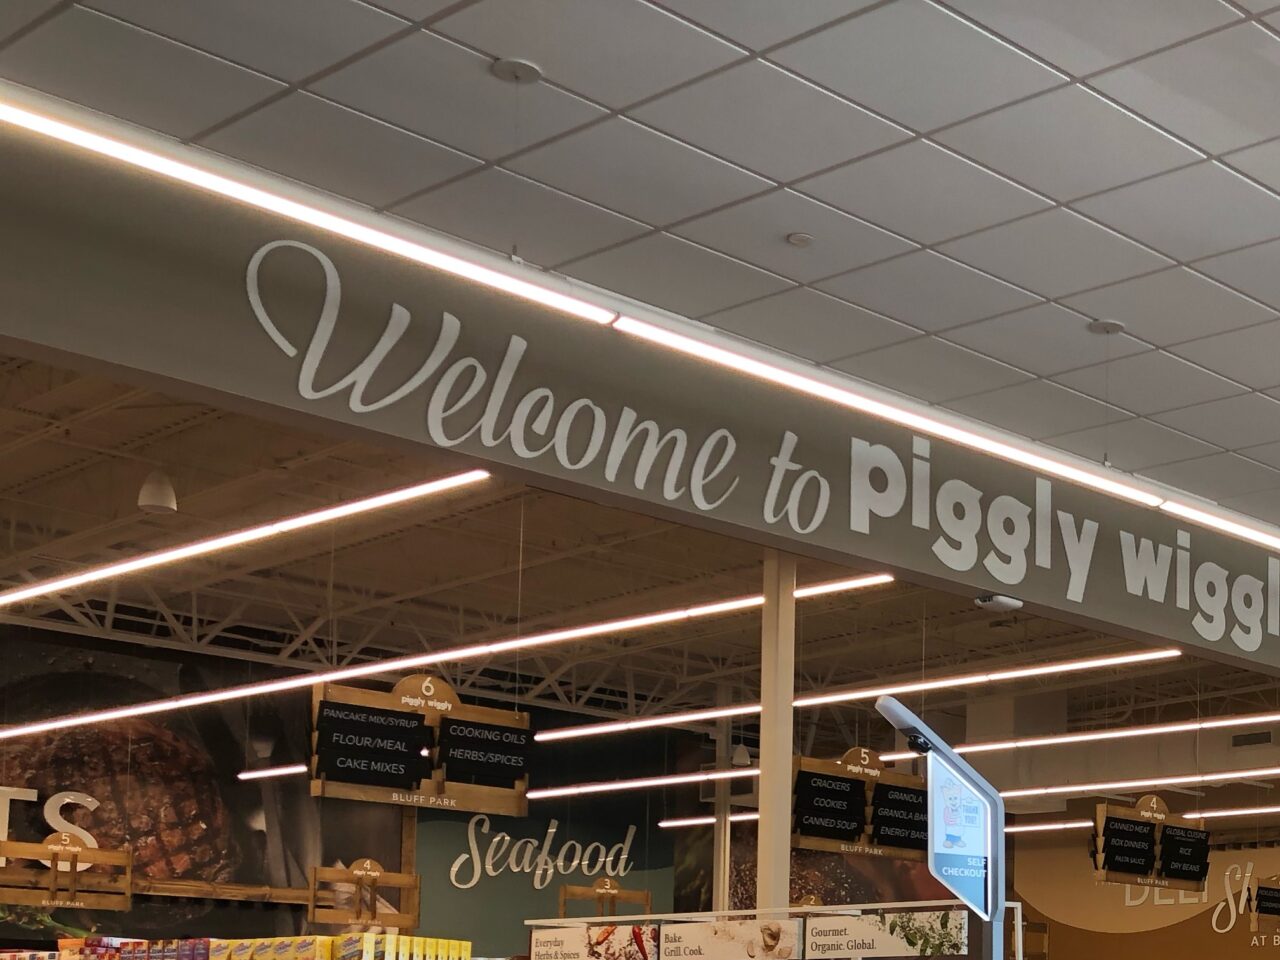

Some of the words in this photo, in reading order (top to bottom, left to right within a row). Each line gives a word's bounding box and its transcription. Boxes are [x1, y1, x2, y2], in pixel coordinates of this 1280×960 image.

[246, 239, 740, 510] Welcome
[763, 430, 831, 534] to
[850, 435, 1099, 603] piggly
[421, 676, 435, 696] 6
[401, 696, 425, 708] piggly
[427, 699, 452, 711] wiggly
[323, 708, 367, 723] PANCAKE
[369, 715, 418, 729] MIX/SYRUP
[450, 725, 500, 741] COOKING
[502, 732, 526, 744] OILS
[333, 733, 408, 752] FLOUR/MEAL
[449, 748, 524, 767] HERBS/SPICES
[860, 749, 870, 765] 5
[336, 757, 368, 770] CAKE
[371, 760, 405, 775] MIXES
[811, 777, 850, 792] CRACKERS
[392, 792, 425, 804] BLUFF
[429, 796, 457, 807] PARK
[813, 797, 848, 810] COOKIES
[888, 791, 923, 804] GRANOLA
[1150, 797, 1157, 811] 4
[878, 807, 913, 821] GRANOLA
[803, 816, 835, 828] CANNED
[836, 819, 857, 831] SOUP
[1110, 821, 1134, 832] CANNED
[1135, 825, 1151, 833] MEAT
[61, 832, 70, 844] 5
[880, 826, 909, 839] ENERGY
[1166, 827, 1186, 837] GLOBAL
[1111, 838, 1124, 847] BOX
[1125, 840, 1149, 850] DINNERS
[450, 814, 637, 890] Seafood
[1179, 847, 1192, 856] RICE
[967, 857, 986, 867] SELF
[1170, 862, 1181, 870] DRY
[942, 867, 986, 877] CHECKOUT
[664, 933, 682, 943] Bake.
[810, 927, 849, 938] Gourmet.
[535, 938, 564, 949] Everyday
[810, 942, 846, 954] Organic.
[846, 939, 877, 951] Global.
[1251, 936, 1267, 946] AT
[534, 952, 553, 960] Herbs
[553, 951, 559, 959] &
[559, 951, 580, 960] Spices
[683, 946, 705, 956] Cook.
